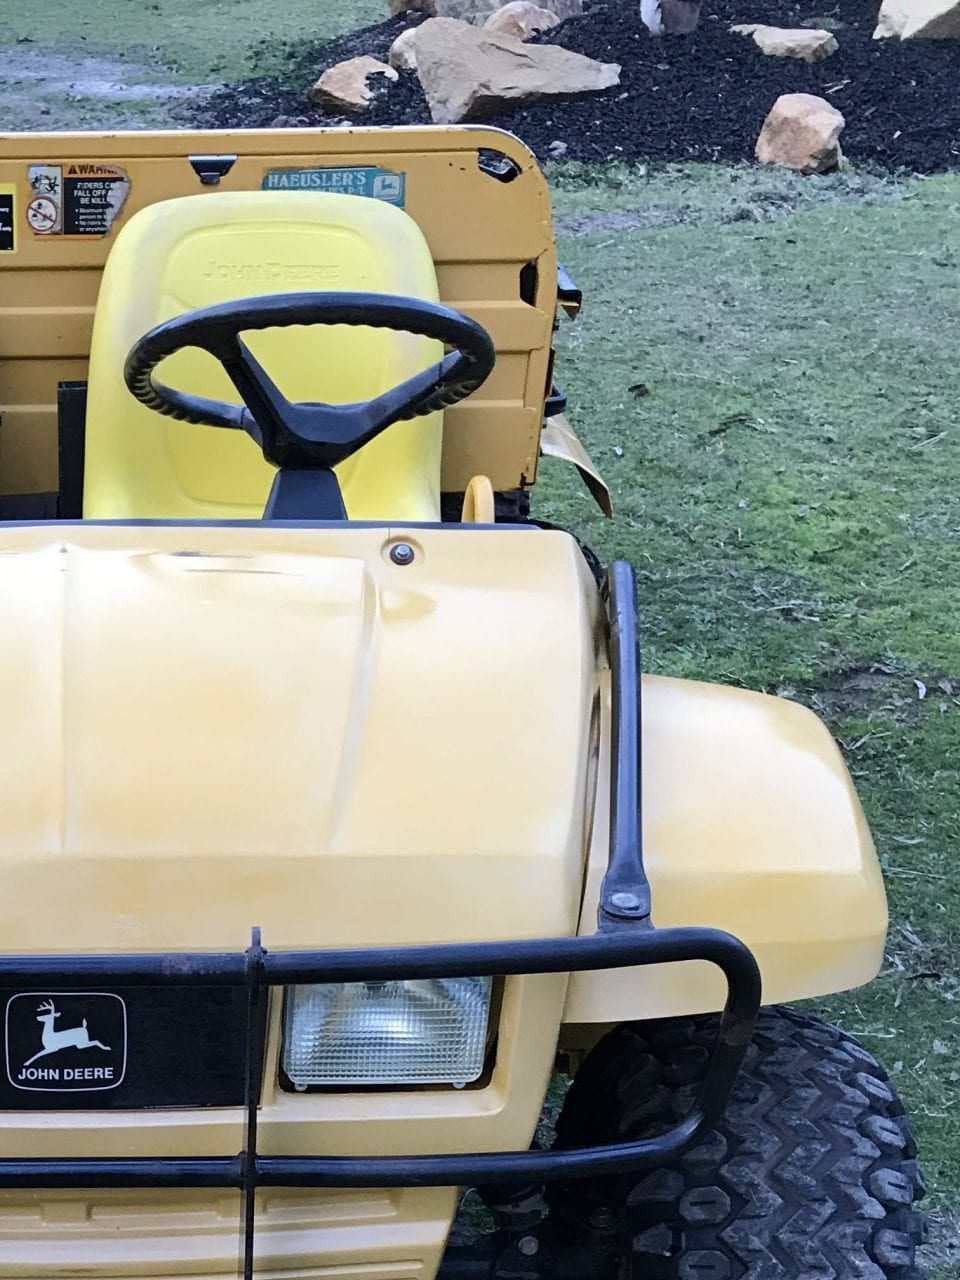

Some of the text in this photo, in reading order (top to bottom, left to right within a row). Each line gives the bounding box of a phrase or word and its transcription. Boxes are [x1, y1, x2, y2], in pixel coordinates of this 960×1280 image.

[78, 164, 118, 174] WARN
[268, 171, 367, 188] HAEUSLER'S
[203, 260, 340, 281] JOHN DEERE
[18, 1067, 114, 1080] JOHN DEERE
